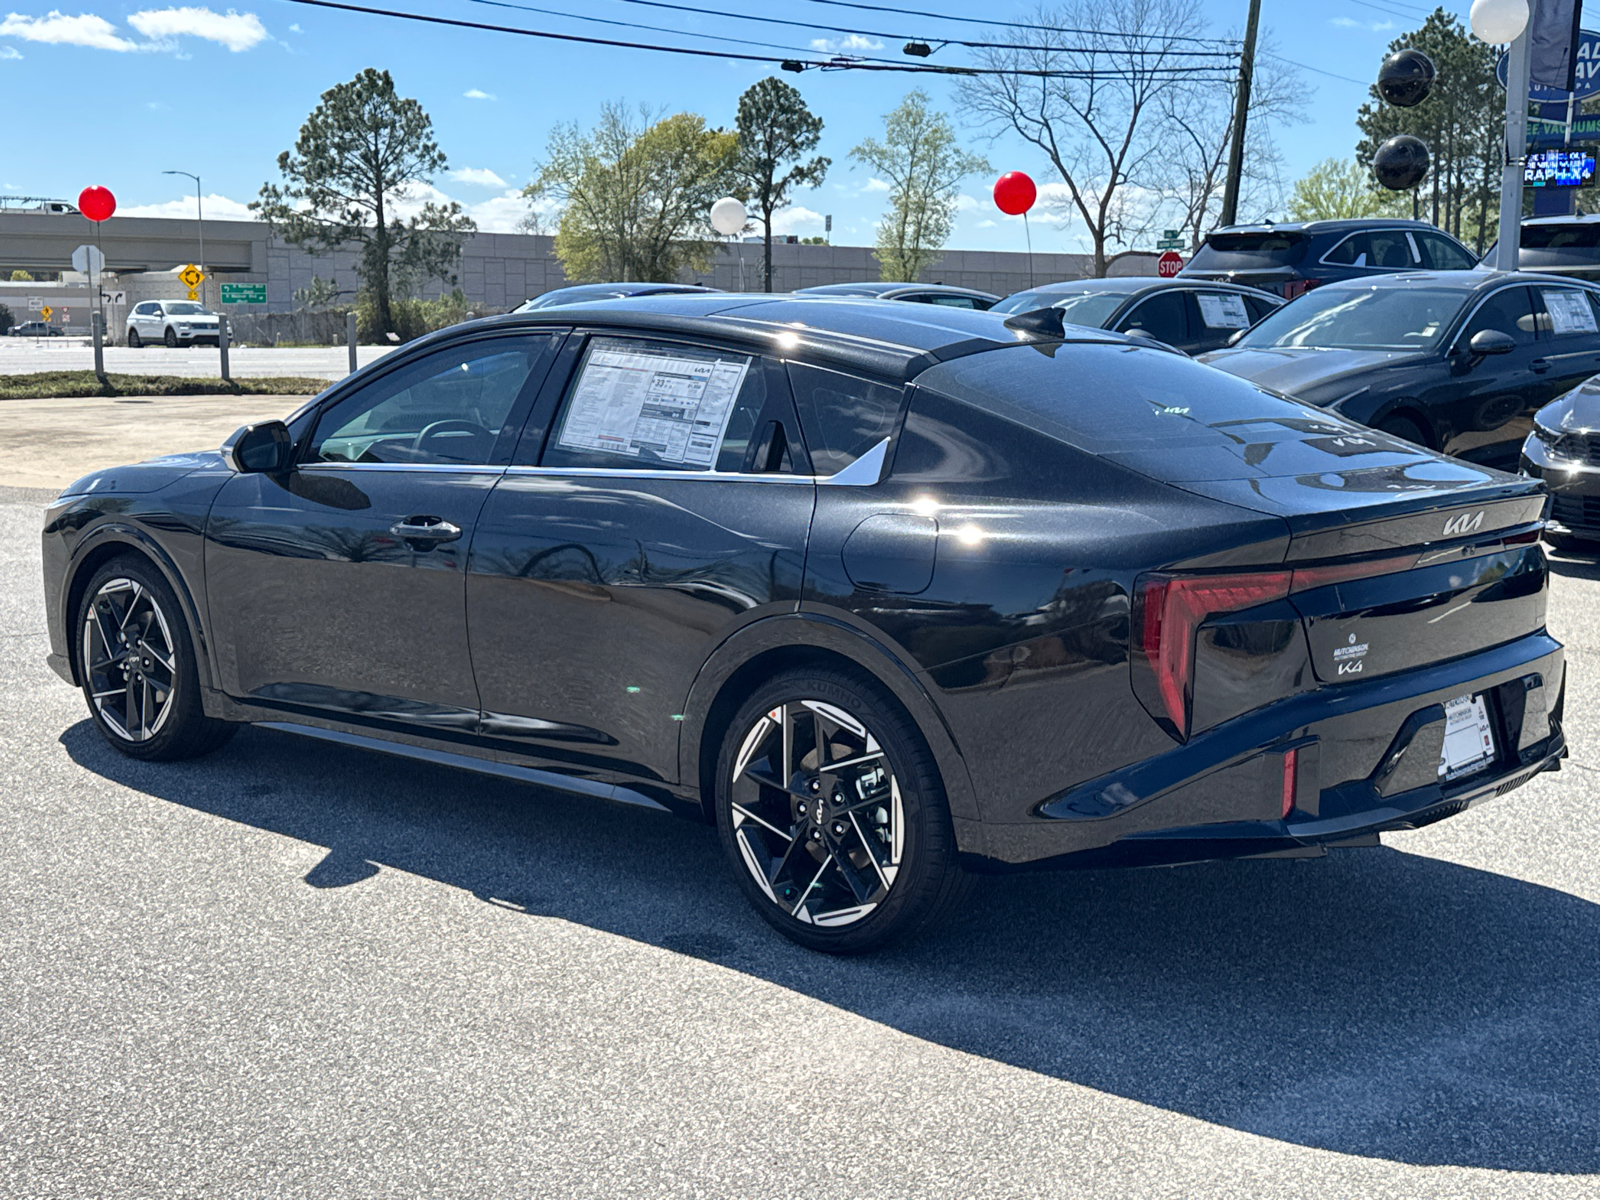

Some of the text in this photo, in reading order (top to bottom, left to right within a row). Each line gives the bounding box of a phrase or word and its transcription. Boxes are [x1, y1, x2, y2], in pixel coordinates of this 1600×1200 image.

[1160, 261, 1182, 274] STOP
[1442, 510, 1485, 536] KIA
[1338, 659, 1363, 675] K4
